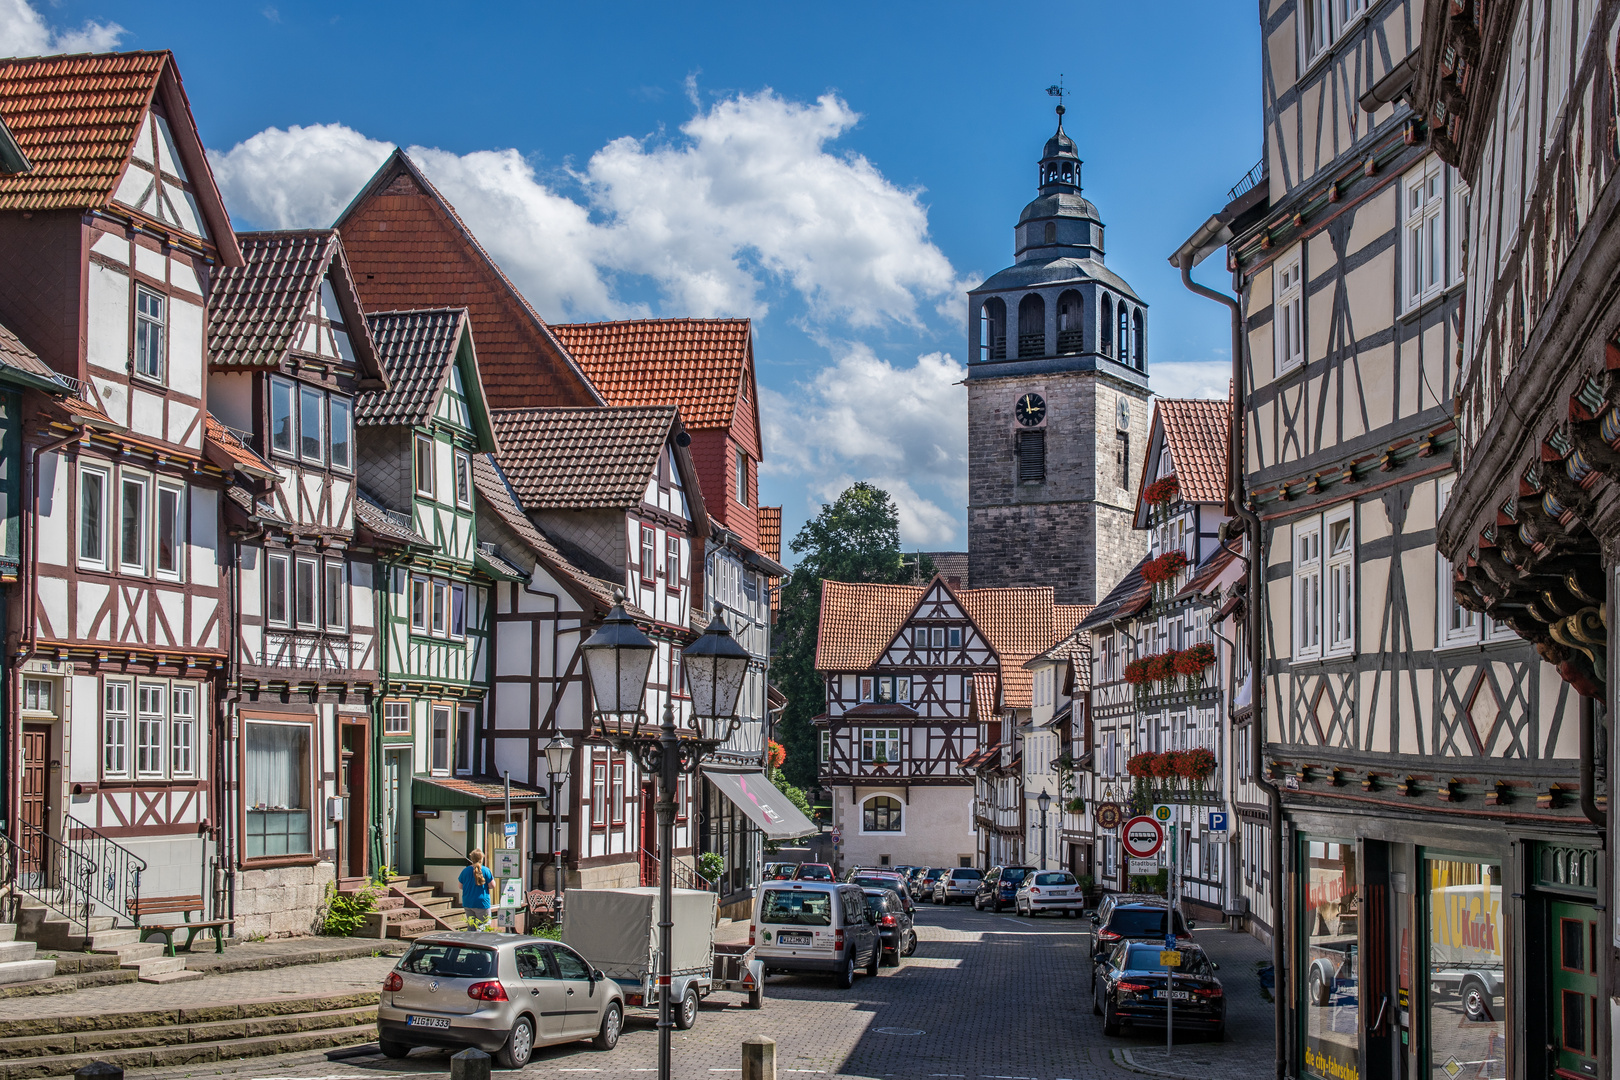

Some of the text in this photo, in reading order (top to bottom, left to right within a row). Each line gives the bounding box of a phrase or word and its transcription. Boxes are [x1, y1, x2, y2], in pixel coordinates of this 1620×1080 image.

[1160, 808, 1167, 818] H
[1213, 814, 1223, 829] P
[1570, 861, 1579, 877] 27
[1305, 876, 1327, 912] Kuck
[1432, 868, 1501, 957] Kuck
[1462, 909, 1495, 951] Kuck
[412, 1016, 426, 1026] HIG
[435, 1019, 449, 1028] 333
[1305, 1046, 1314, 1066] die
